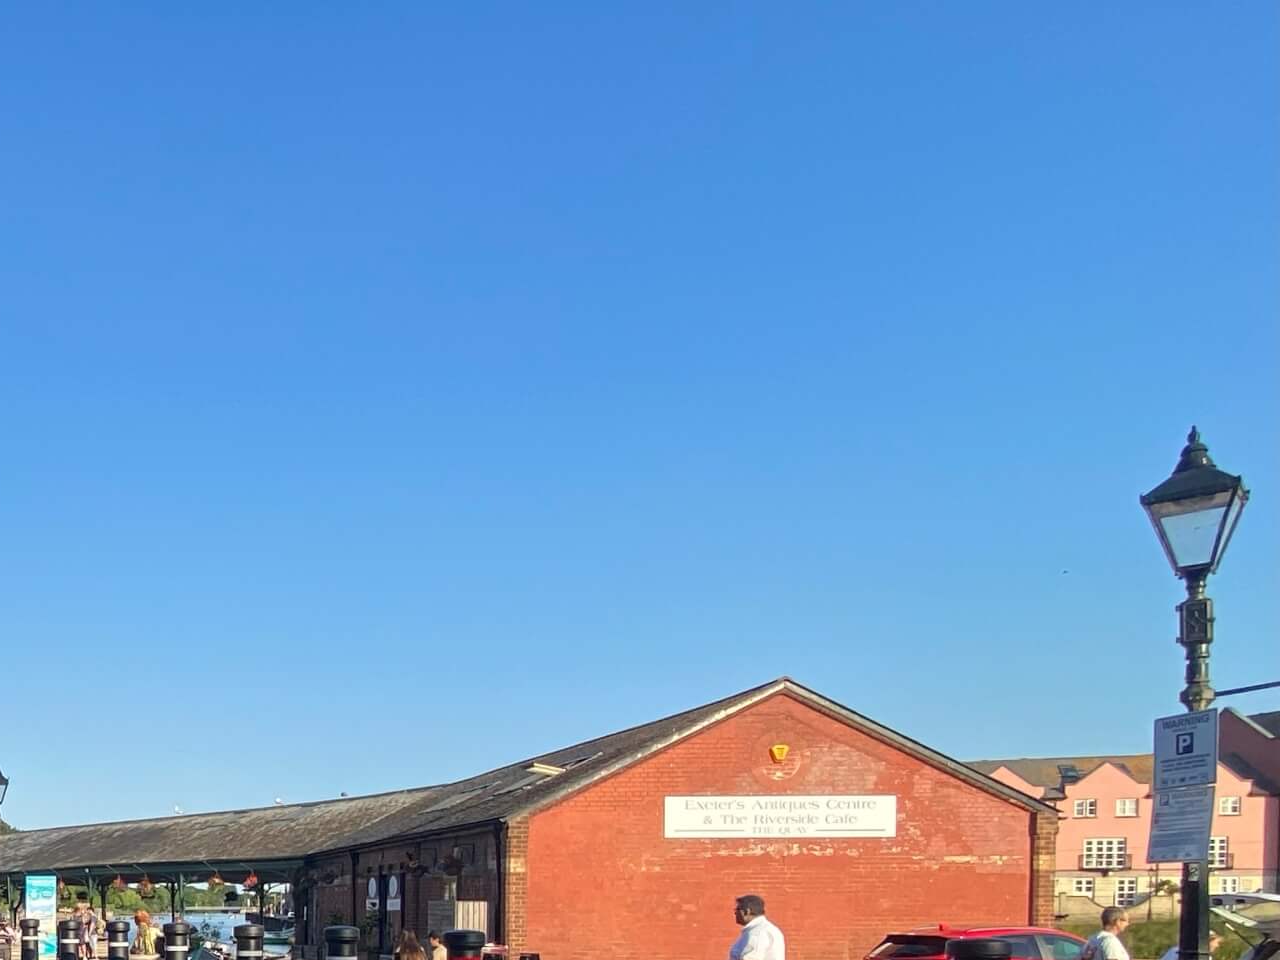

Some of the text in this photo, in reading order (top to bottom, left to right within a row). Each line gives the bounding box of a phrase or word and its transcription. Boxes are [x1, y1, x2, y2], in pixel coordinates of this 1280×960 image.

[1162, 713, 1209, 729] WARNING
[1178, 734, 1191, 754] P
[684, 799, 877, 812] Exeter's Antiques Centre
[703, 815, 713, 825] &
[720, 814, 748, 825] The
[754, 814, 820, 825] Riverside
